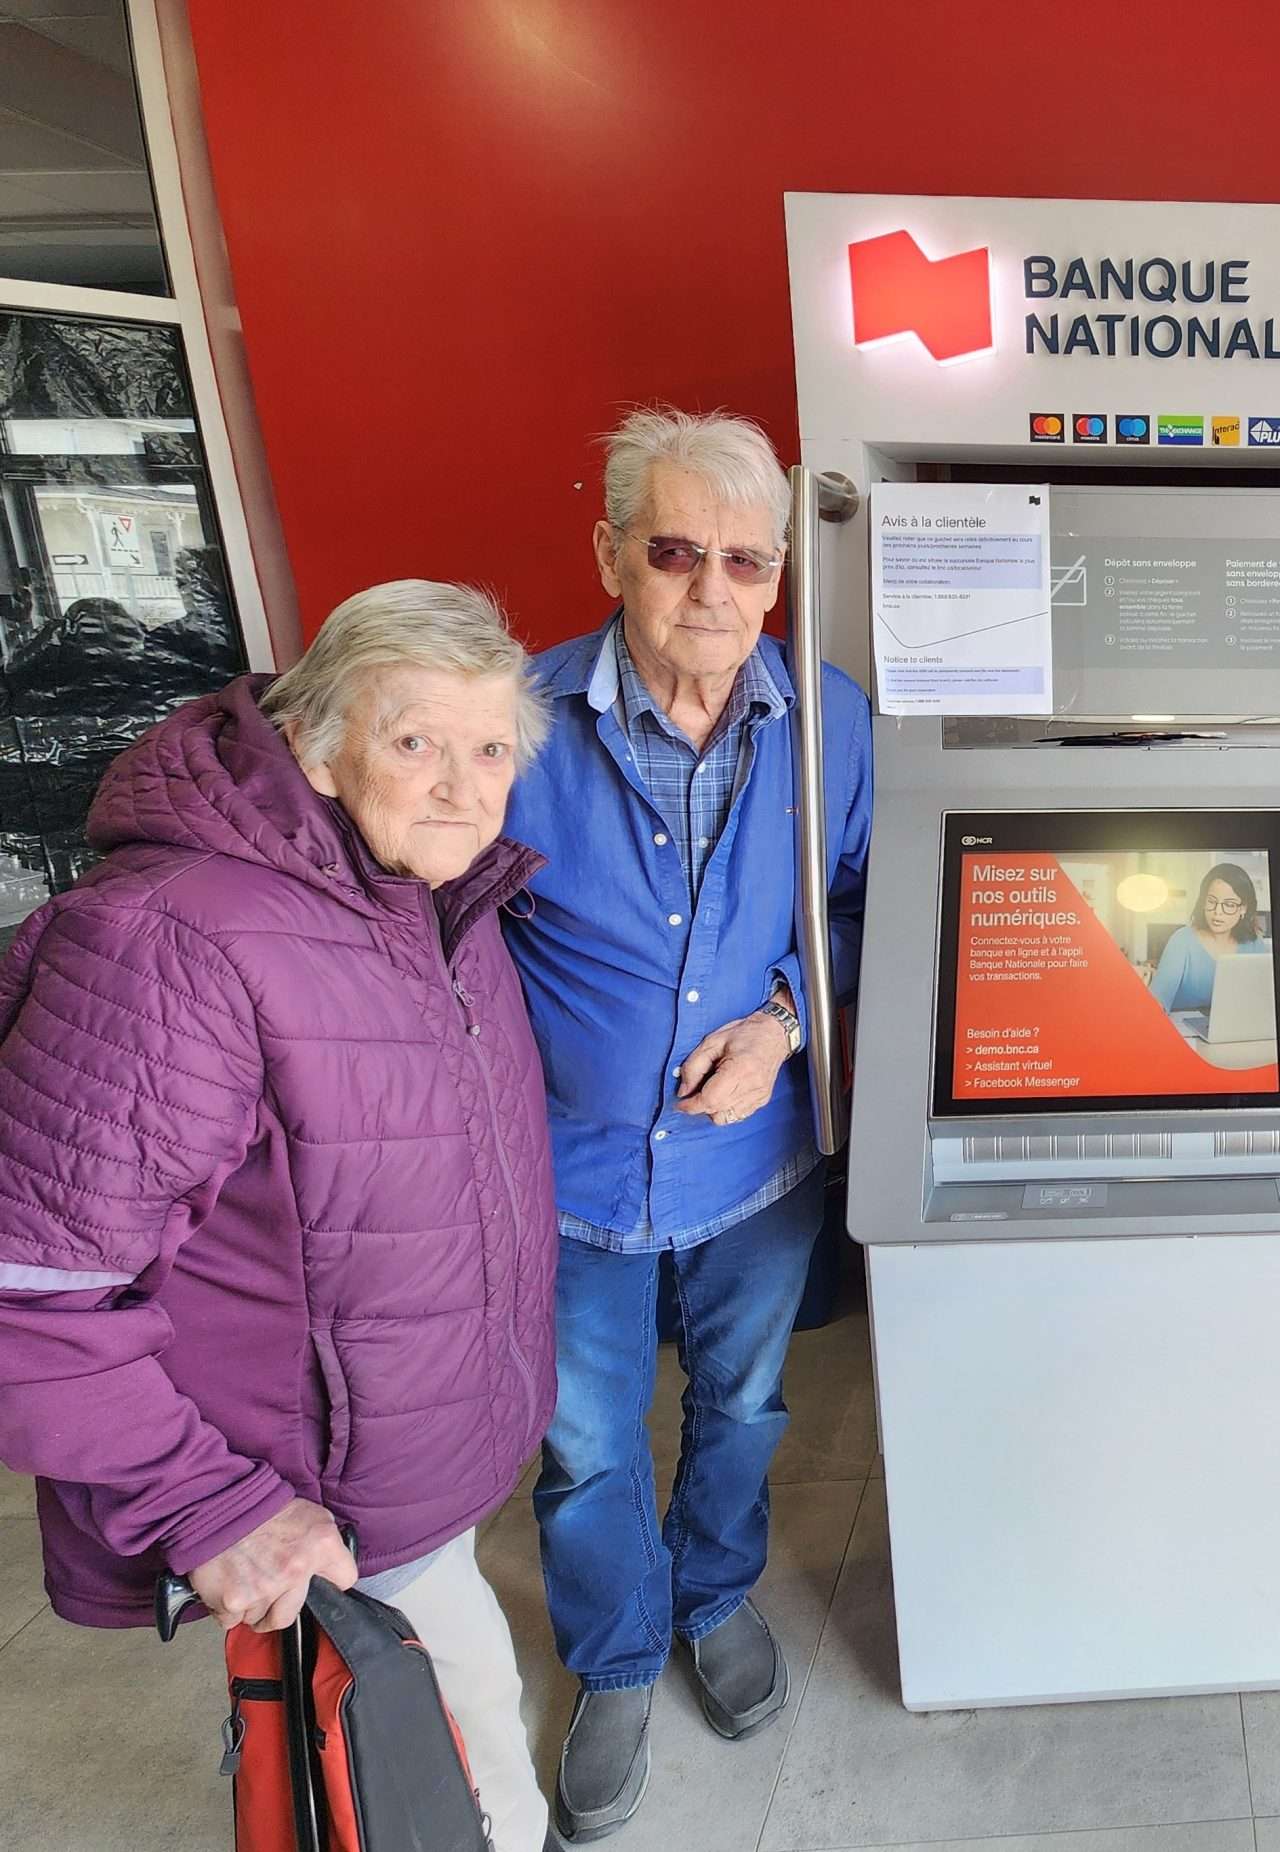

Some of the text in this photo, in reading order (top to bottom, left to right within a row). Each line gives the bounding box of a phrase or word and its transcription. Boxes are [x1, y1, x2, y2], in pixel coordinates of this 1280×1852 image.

[1023, 255, 1251, 304] BANQUE
[881, 515, 986, 528] Avis à la clientèle
[1153, 559, 1197, 568] enveloppe
[1225, 559, 1266, 568] Paiement
[1266, 560, 1277, 568] de
[883, 656, 943, 664] Notice to clients
[972, 864, 1058, 882] Misez sur
[971, 886, 1057, 904] nos outils
[970, 908, 1081, 929] numériques.
[970, 935, 1072, 946] Connectez-vous à votre
[970, 948, 1003, 959] banque
[1005, 949, 1016, 957] en
[1018, 948, 1039, 959] ligne
[1040, 948, 1050, 956] et
[1051, 947, 1057, 956] à
[969, 959, 1089, 970] Banque Nationale pour faire
[969, 971, 1043, 981] vos transactions.
[967, 1028, 1000, 1039] Besoin
[1001, 1027, 1031, 1038] d'aide
[975, 1044, 1039, 1055] demo.bnc.ca
[974, 1061, 1020, 1071] Assistant
[1022, 1060, 1053, 1070] virtuel
[974, 1077, 1022, 1088] Facebook
[1024, 1076, 1080, 1088] Messenger
